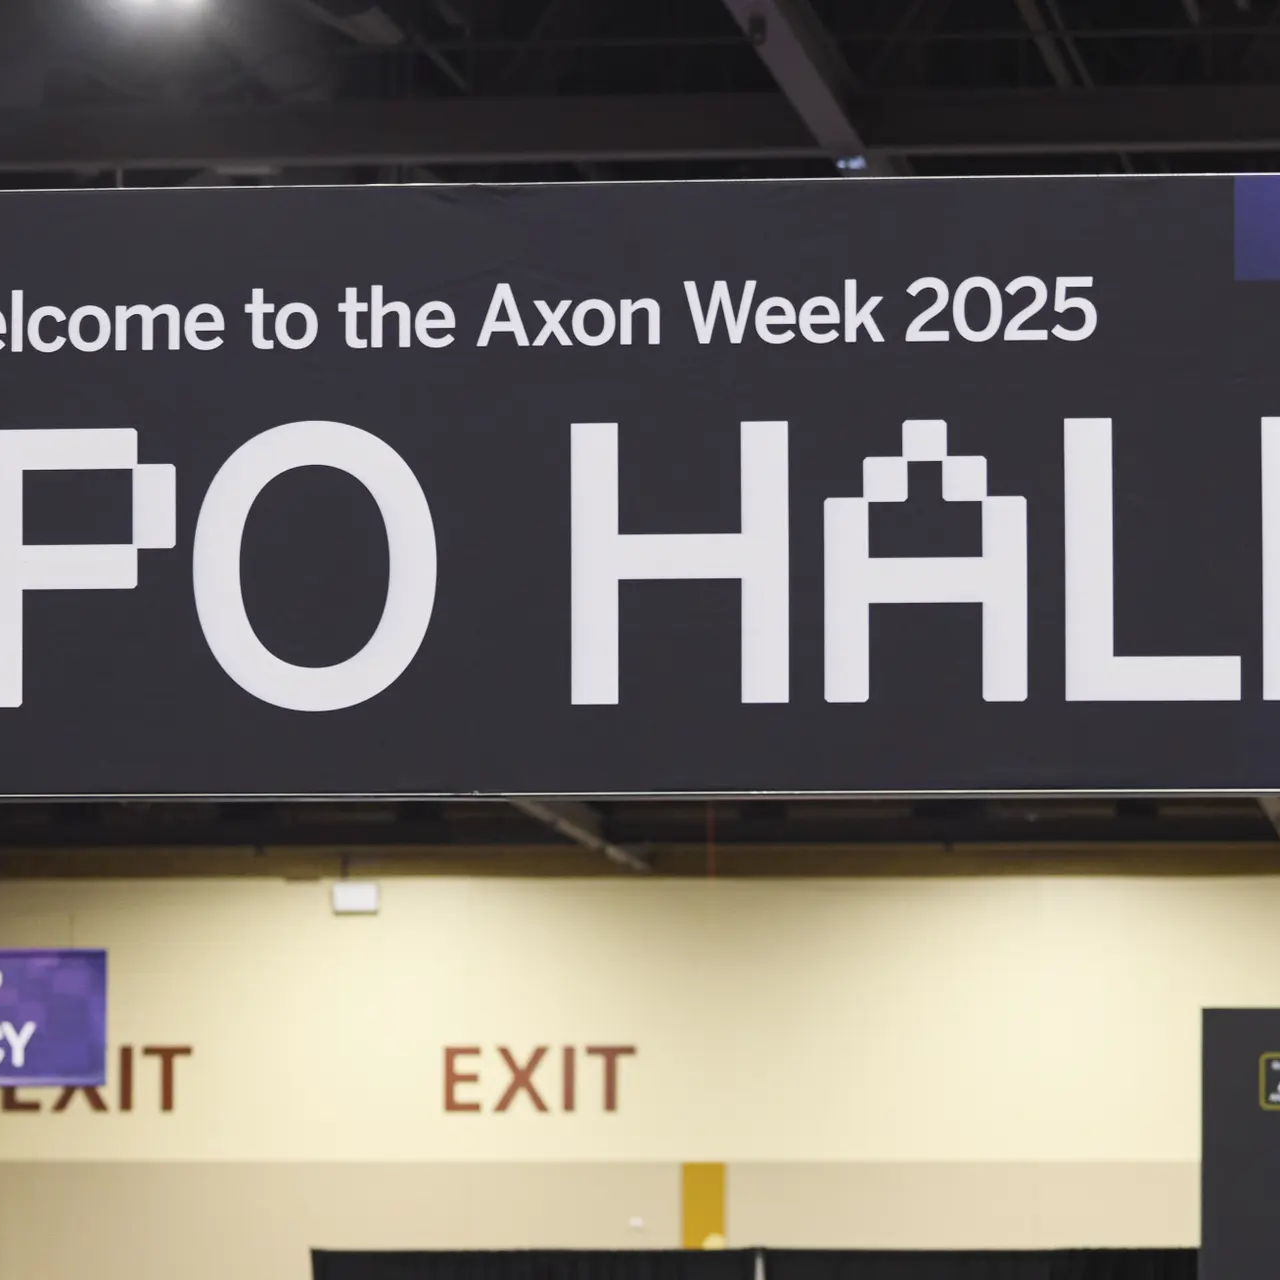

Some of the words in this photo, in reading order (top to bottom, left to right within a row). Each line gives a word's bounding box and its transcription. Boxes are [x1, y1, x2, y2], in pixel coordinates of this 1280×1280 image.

[245, 288, 318, 349] to
[338, 285, 455, 348] the
[477, 283, 660, 346] Axon
[684, 279, 884, 344] Week
[906, 276, 1097, 342] 2025
[444, 1045, 638, 1113] EXIT
